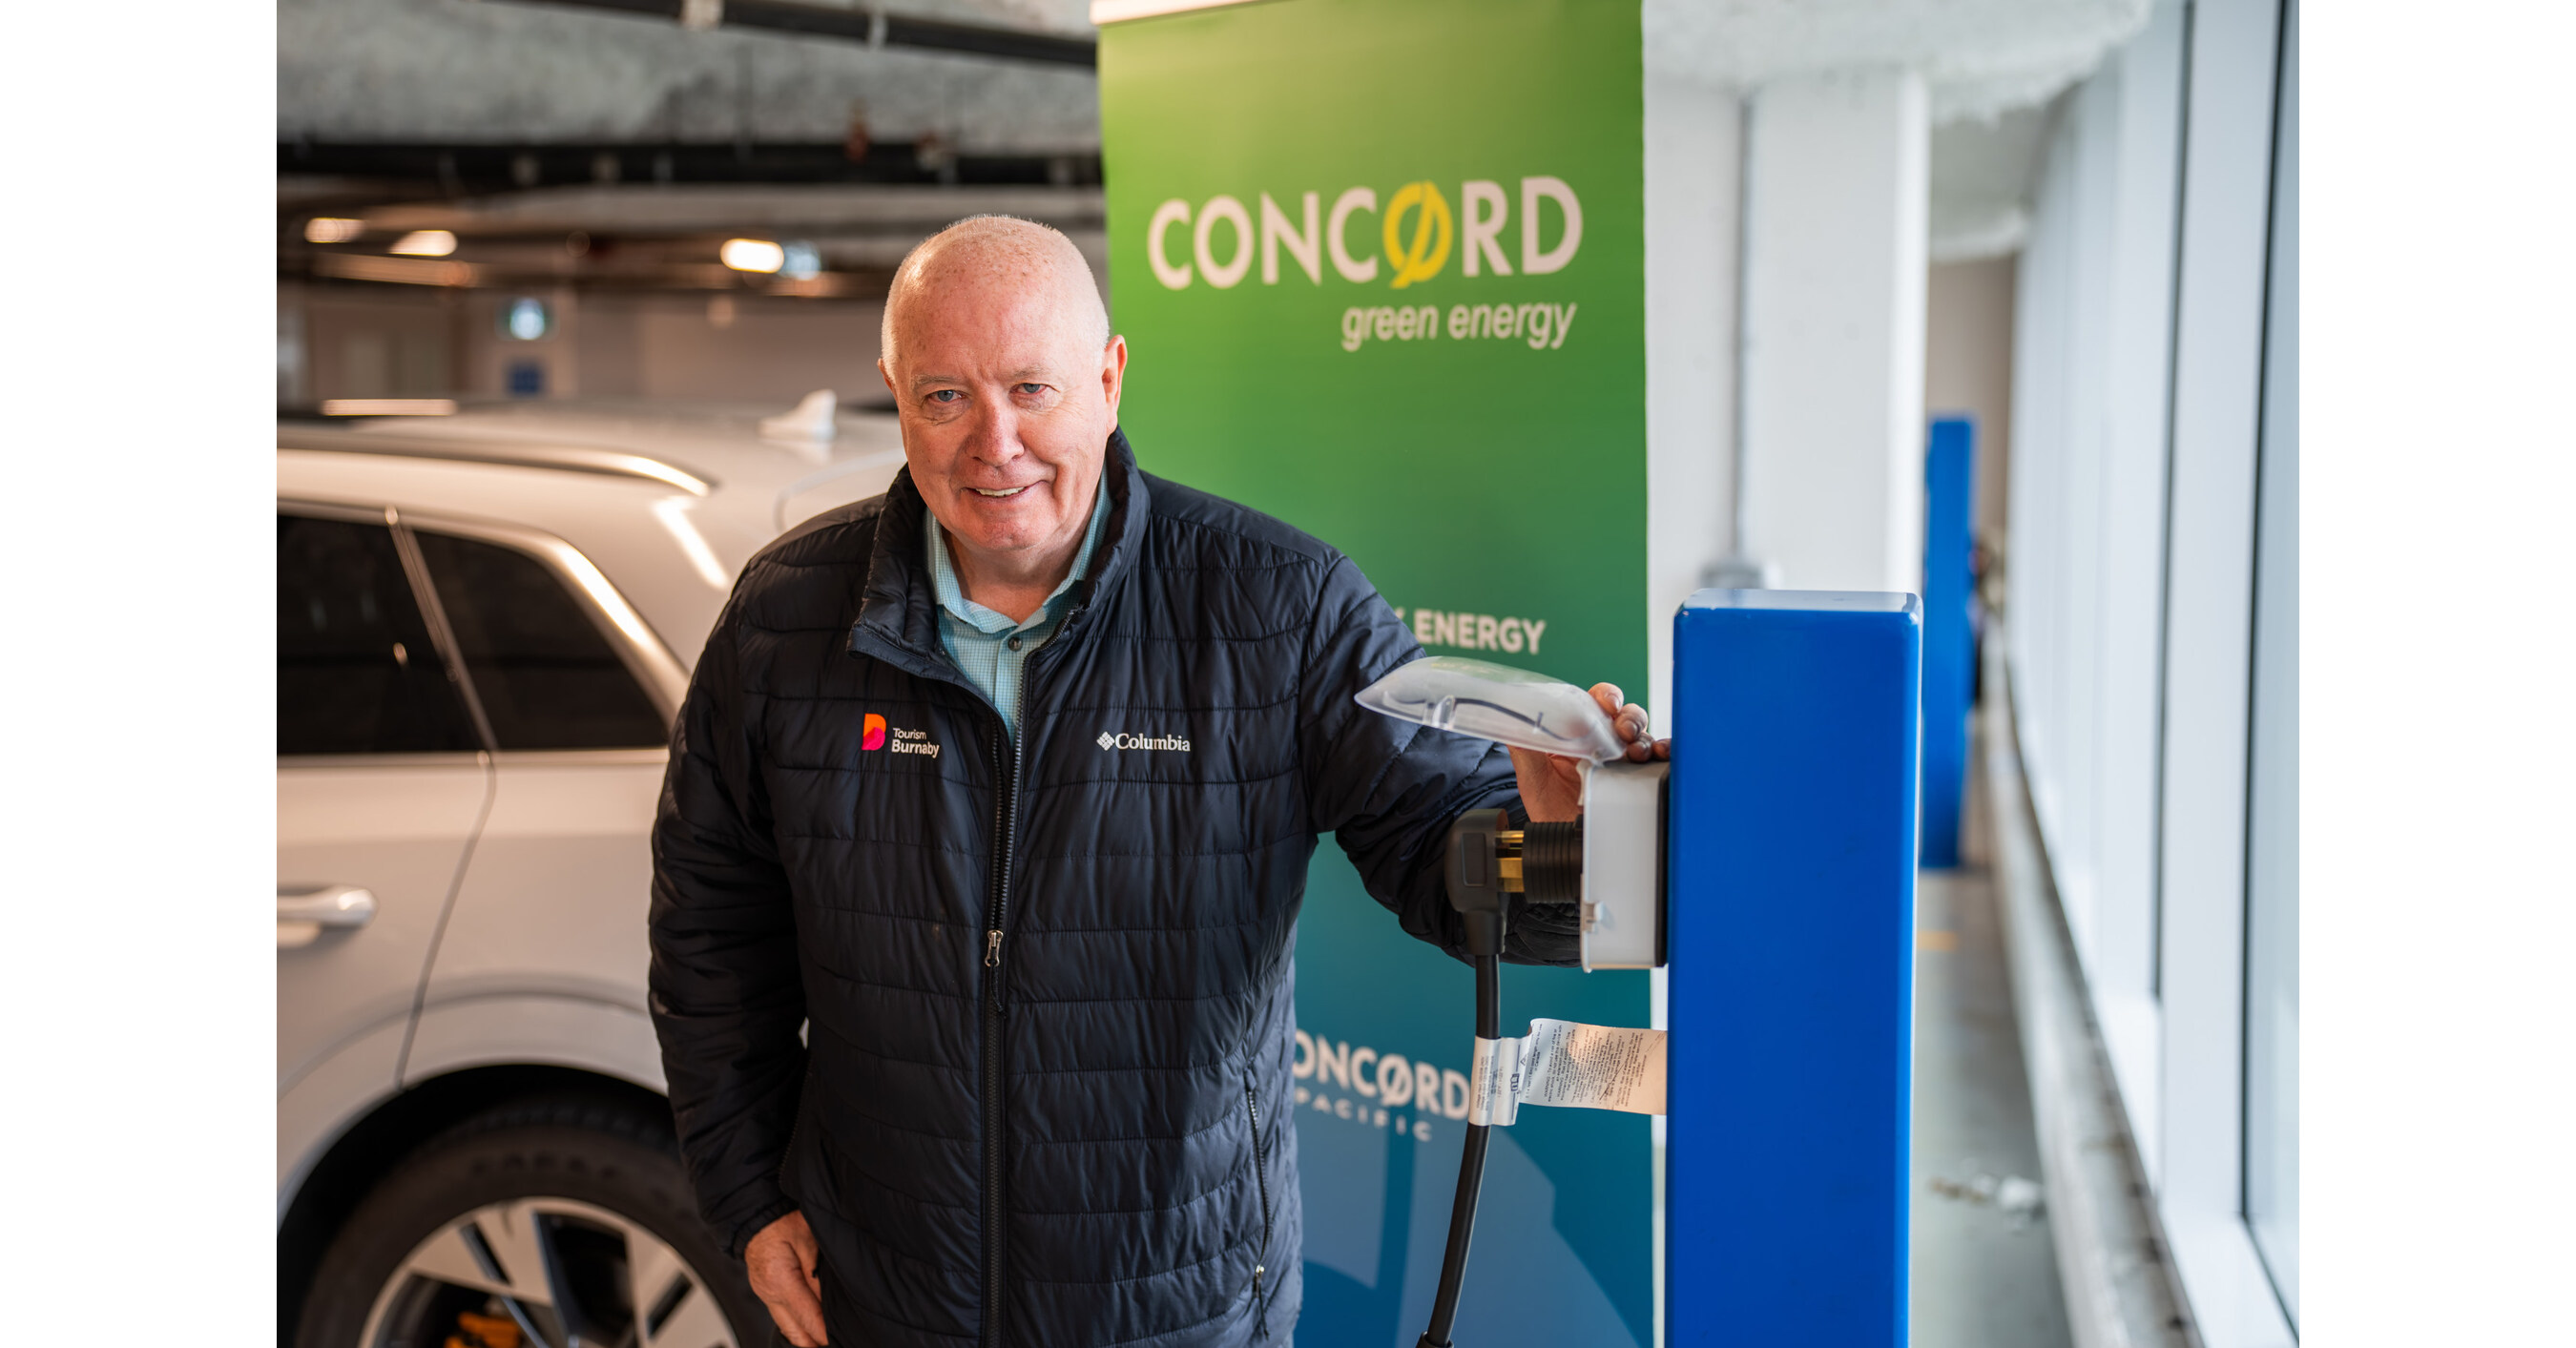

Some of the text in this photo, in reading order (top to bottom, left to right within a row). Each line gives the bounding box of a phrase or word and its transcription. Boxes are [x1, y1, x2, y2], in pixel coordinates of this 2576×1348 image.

[1340, 302, 1578, 352] green energy
[1414, 608, 1547, 655] ENERGY
[893, 727, 926, 739] Tourism
[1114, 733, 1191, 752] Columbia
[891, 738, 940, 758] Burnaby
